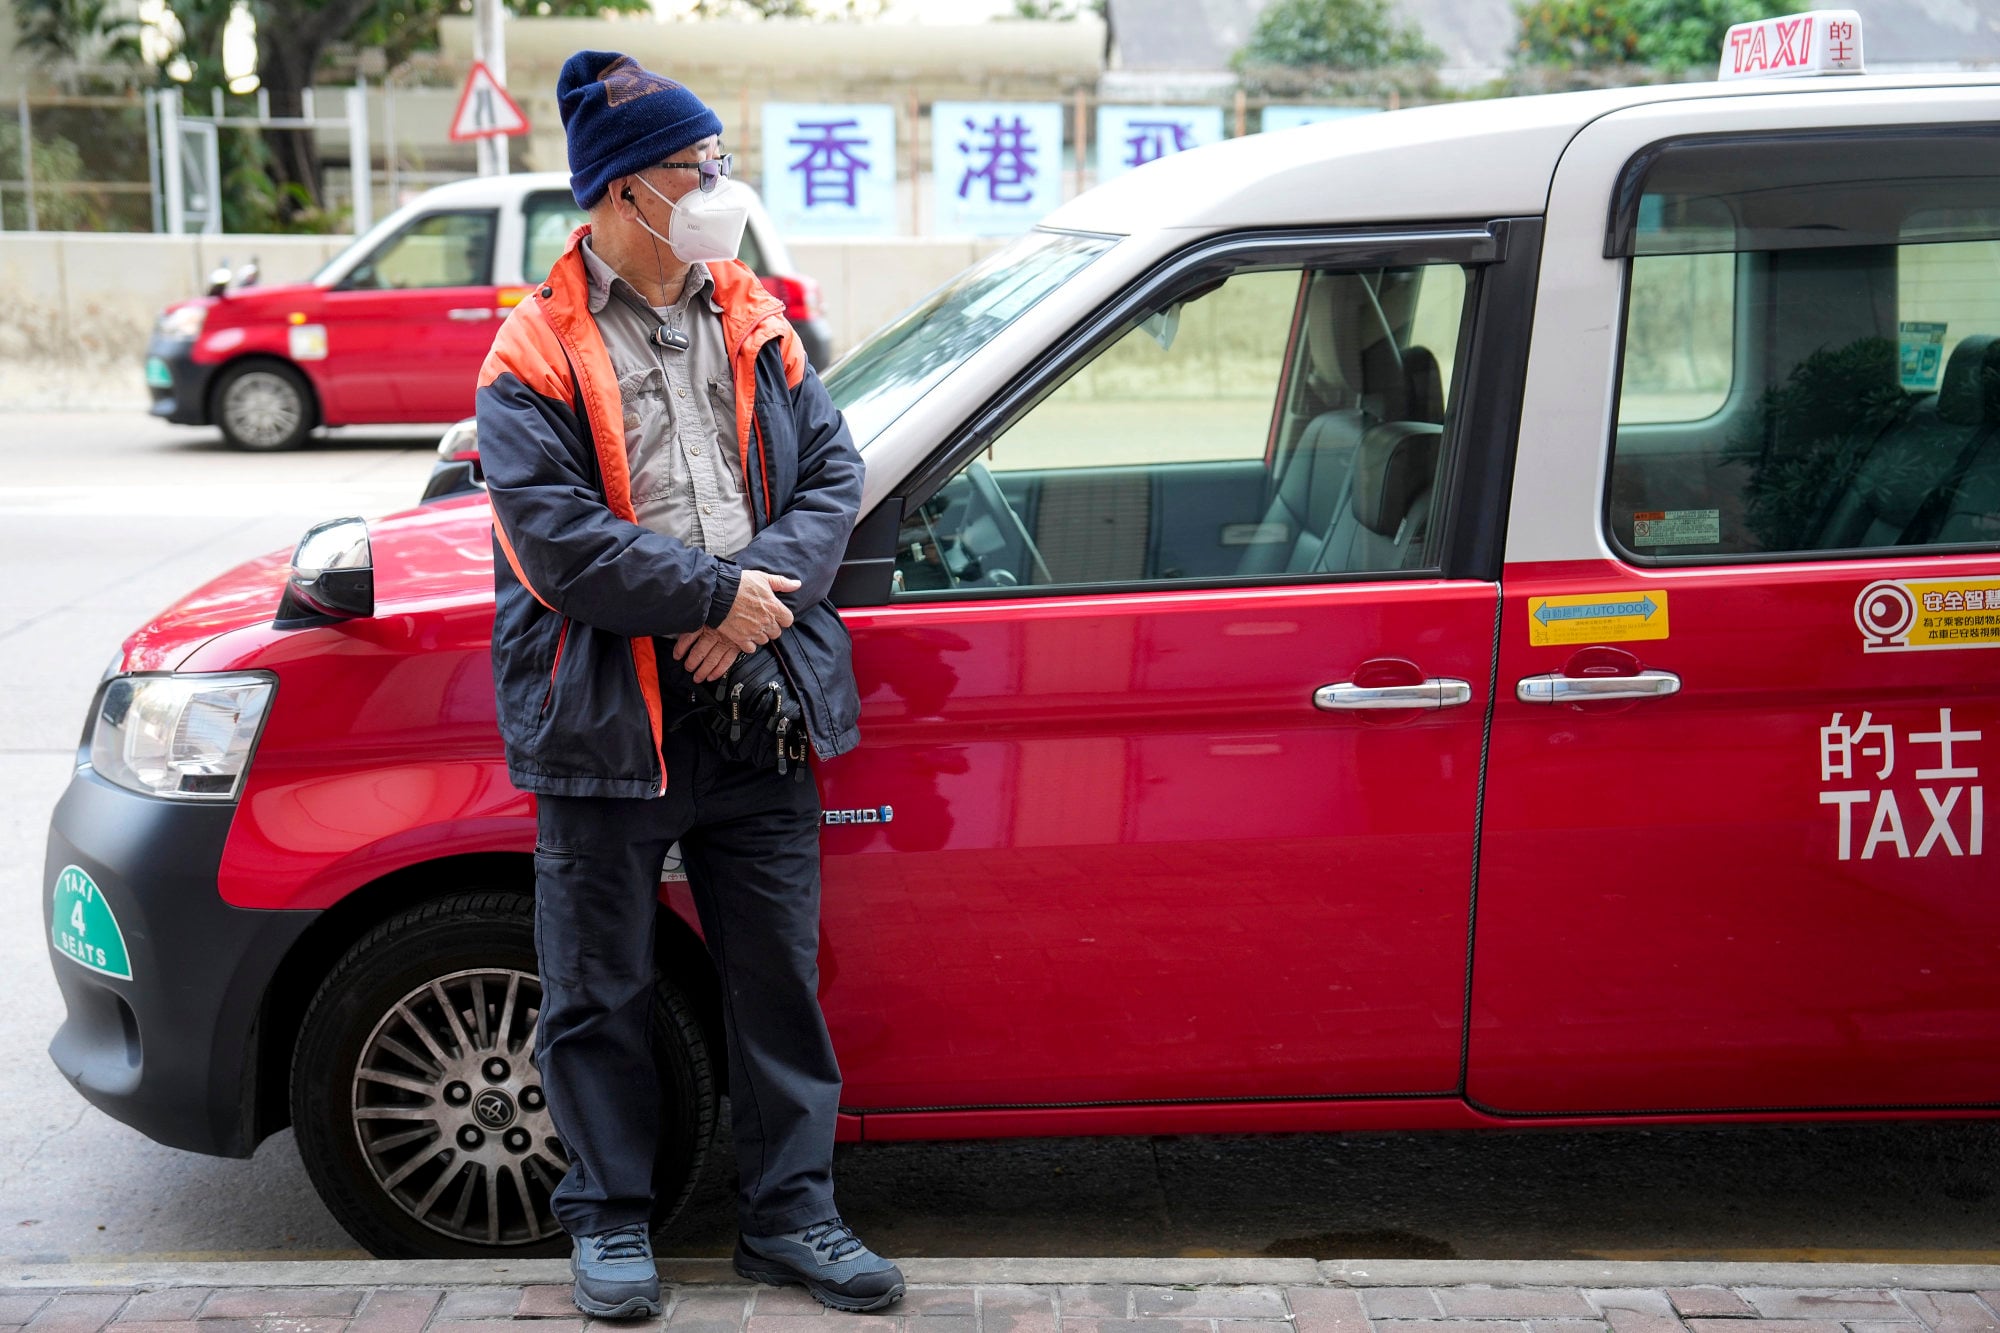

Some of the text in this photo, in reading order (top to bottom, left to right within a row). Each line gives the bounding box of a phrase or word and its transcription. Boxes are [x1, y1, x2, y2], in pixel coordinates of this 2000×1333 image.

[1731, 17, 1813, 73] TAXI
[1829, 21, 1853, 61] 的士
[1585, 604, 1615, 617] AUTO
[1617, 603, 1650, 615] DOOR
[1923, 588, 2000, 613] 安全智慧
[1820, 708, 1982, 781] 的士
[820, 808, 878, 825] BRID
[1819, 785, 1984, 861] TAXI
[64, 873, 93, 903] TAXI
[71, 900, 86, 937] 4
[61, 931, 107, 966] SEATS
